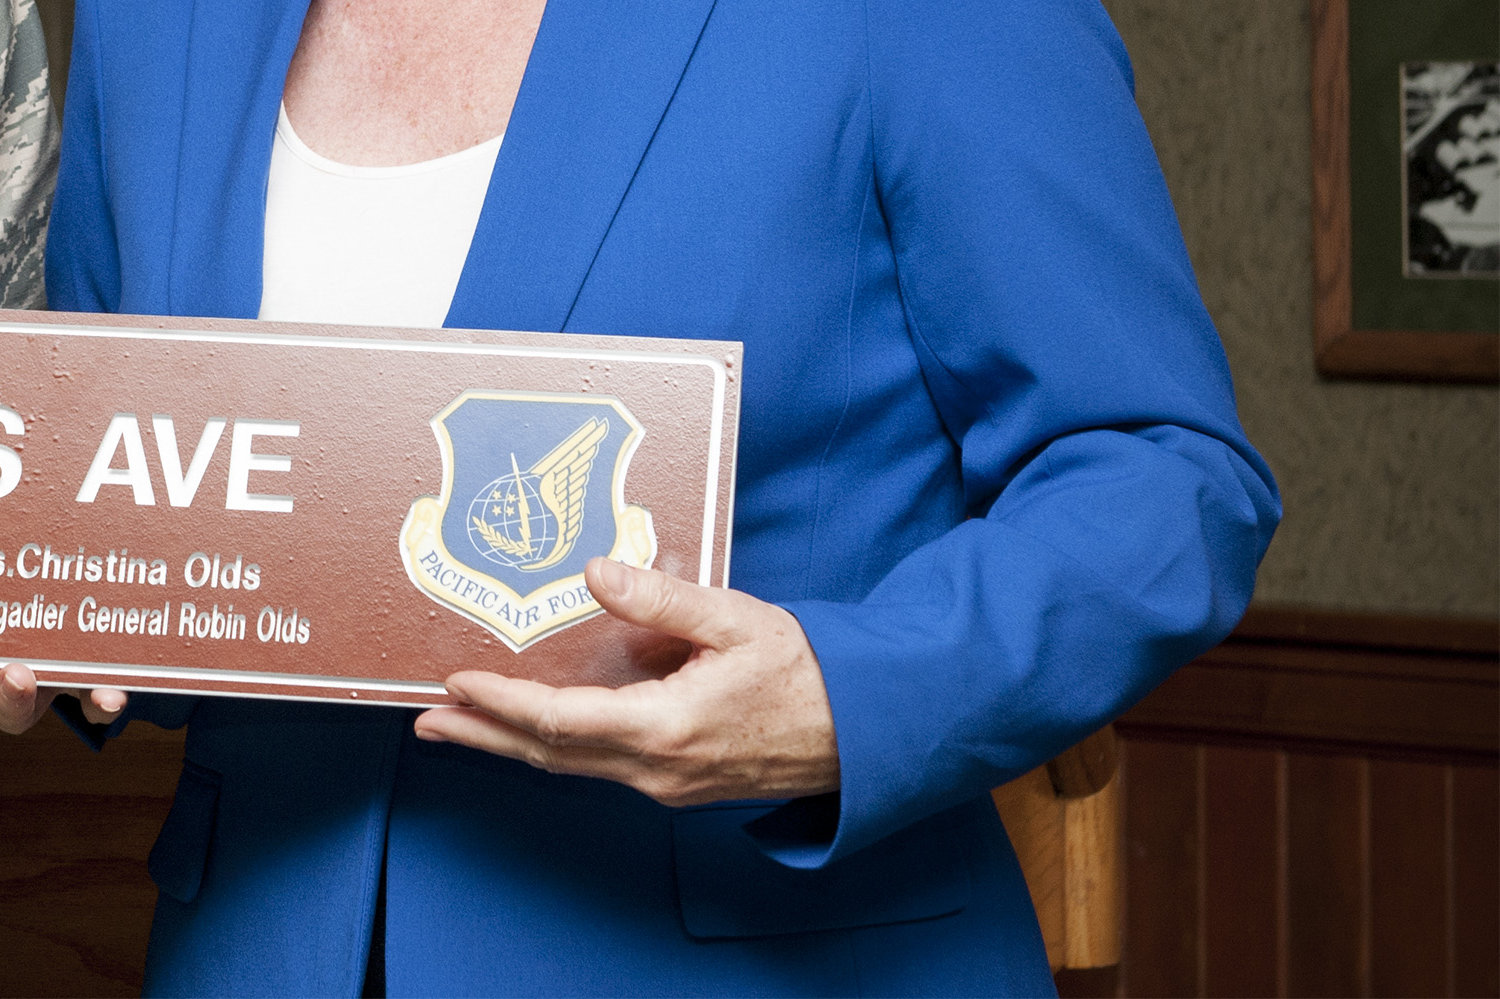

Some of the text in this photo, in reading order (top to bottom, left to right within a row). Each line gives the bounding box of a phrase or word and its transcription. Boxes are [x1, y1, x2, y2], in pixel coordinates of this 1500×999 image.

[75, 412, 300, 513] AVE
[184, 552, 261, 590] Olds
[419, 550, 593, 630] PACIFIC AIR FOR
[78, 596, 170, 636] General
[178, 602, 246, 640] Robin
[257, 605, 311, 645] Olds
